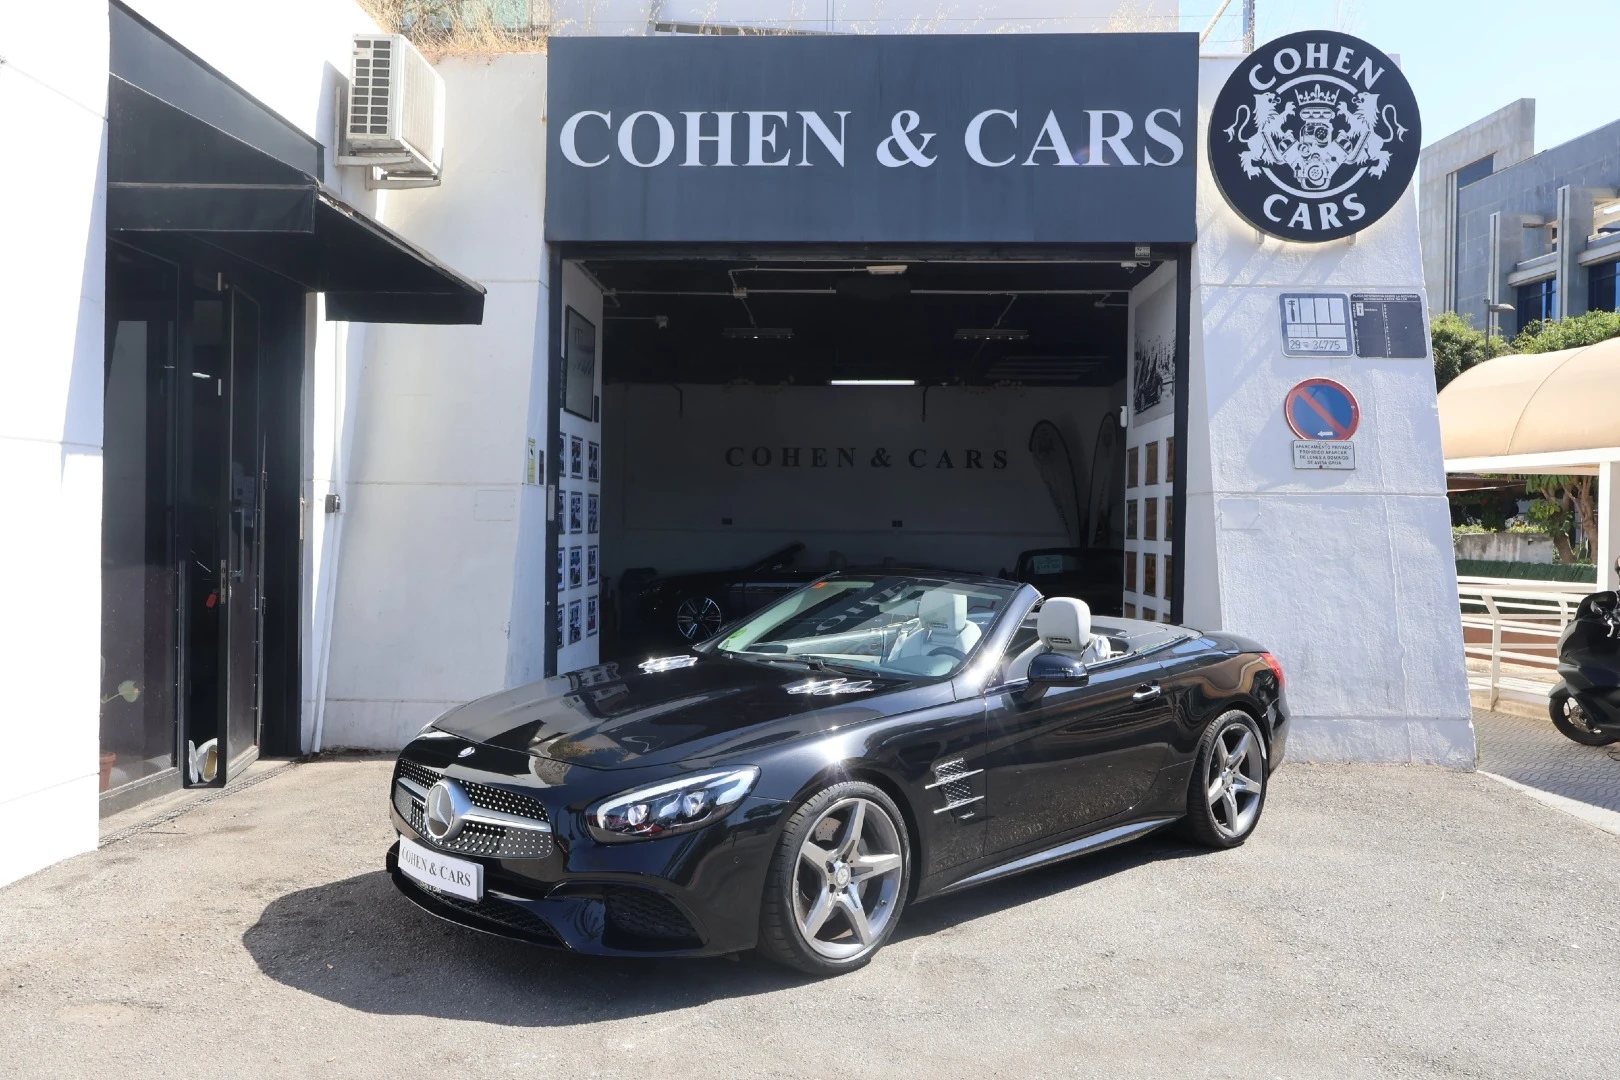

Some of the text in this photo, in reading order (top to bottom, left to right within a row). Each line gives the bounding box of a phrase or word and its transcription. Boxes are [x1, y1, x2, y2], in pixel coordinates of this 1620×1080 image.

[1248, 42, 1386, 92] COHEN
[559, 108, 1185, 169] COHEN & CARS
[1262, 192, 1366, 231] CARS
[725, 446, 1009, 470] COHEN & CARS
[402, 847, 471, 887] COHEN & CARS
